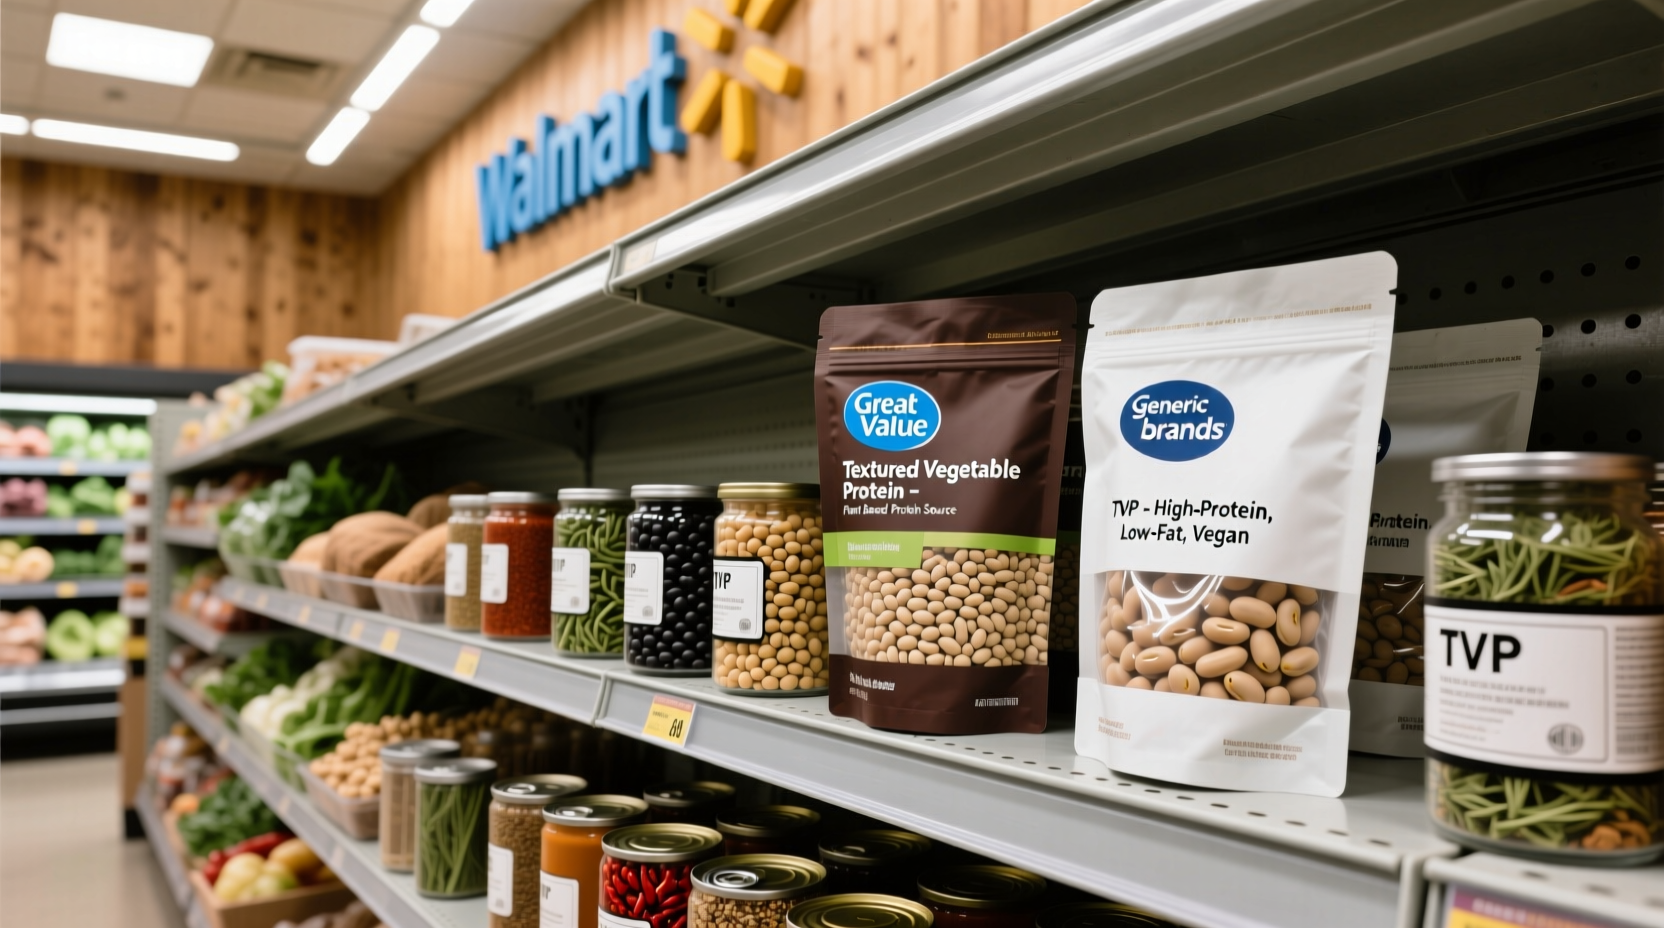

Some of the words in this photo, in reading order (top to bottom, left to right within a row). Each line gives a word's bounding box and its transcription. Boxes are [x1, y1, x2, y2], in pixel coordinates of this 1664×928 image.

[476, 27, 687, 252] Walmart
[854, 393, 918, 415] Great
[1132, 394, 1209, 420] Generic
[860, 414, 928, 437] Value
[1140, 416, 1225, 441] brands
[842, 459, 920, 479] Textured
[923, 458, 1021, 485] Vegetable
[843, 481, 905, 500] Protein
[1112, 499, 1140, 518] TVP
[1154, 498, 1273, 524] High-Protein,
[1120, 523, 1187, 545] Low-Fat,
[1192, 524, 1250, 548] Vegan
[1439, 628, 1522, 674] TVP
